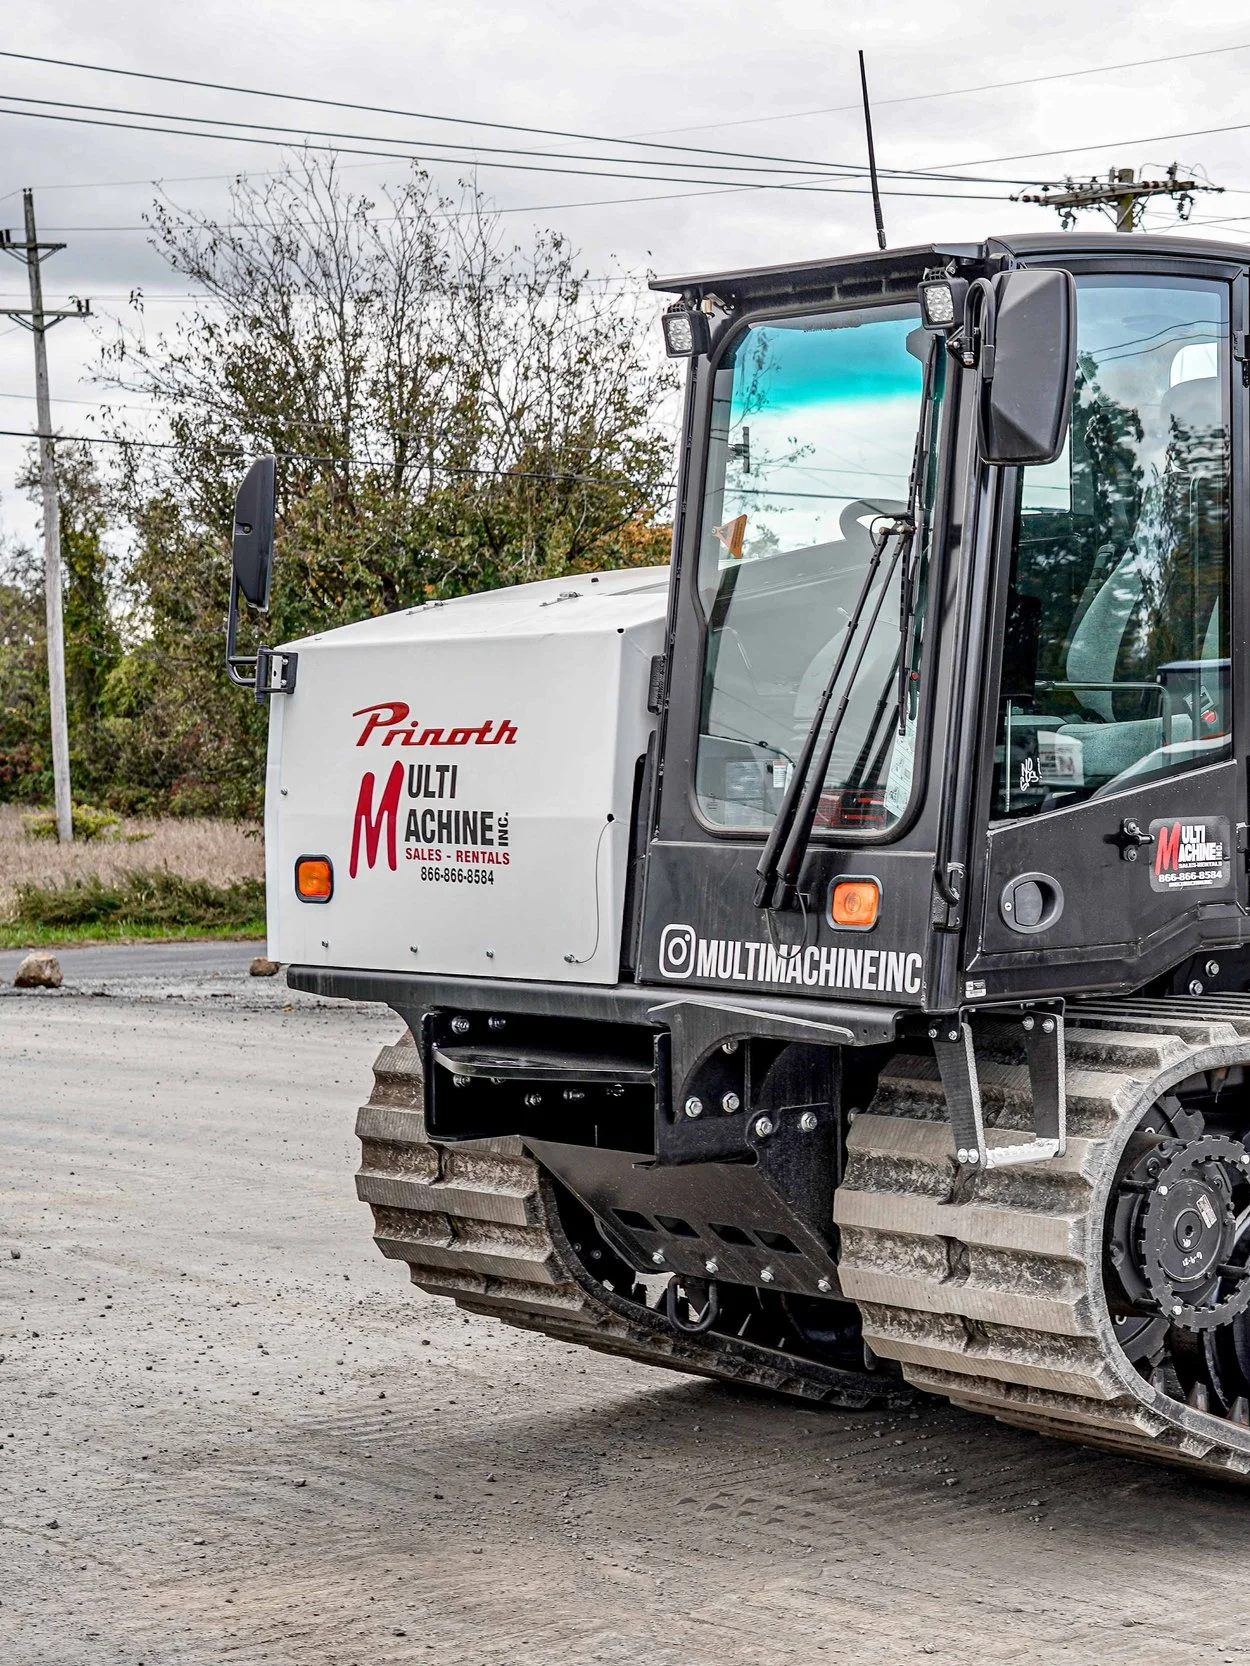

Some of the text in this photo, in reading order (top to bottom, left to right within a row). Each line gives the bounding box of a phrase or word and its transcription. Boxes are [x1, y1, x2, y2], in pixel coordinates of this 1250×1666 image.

[352, 701, 518, 746] Prinoth
[497, 812, 509, 847] INC.
[405, 847, 442, 861] SALES
[456, 849, 510, 865] RENTALS
[421, 866, 495, 885] 866-866-8584
[1159, 870, 1222, 883] 866-866-8584
[696, 938, 922, 994] MULTIMACHINEINC
